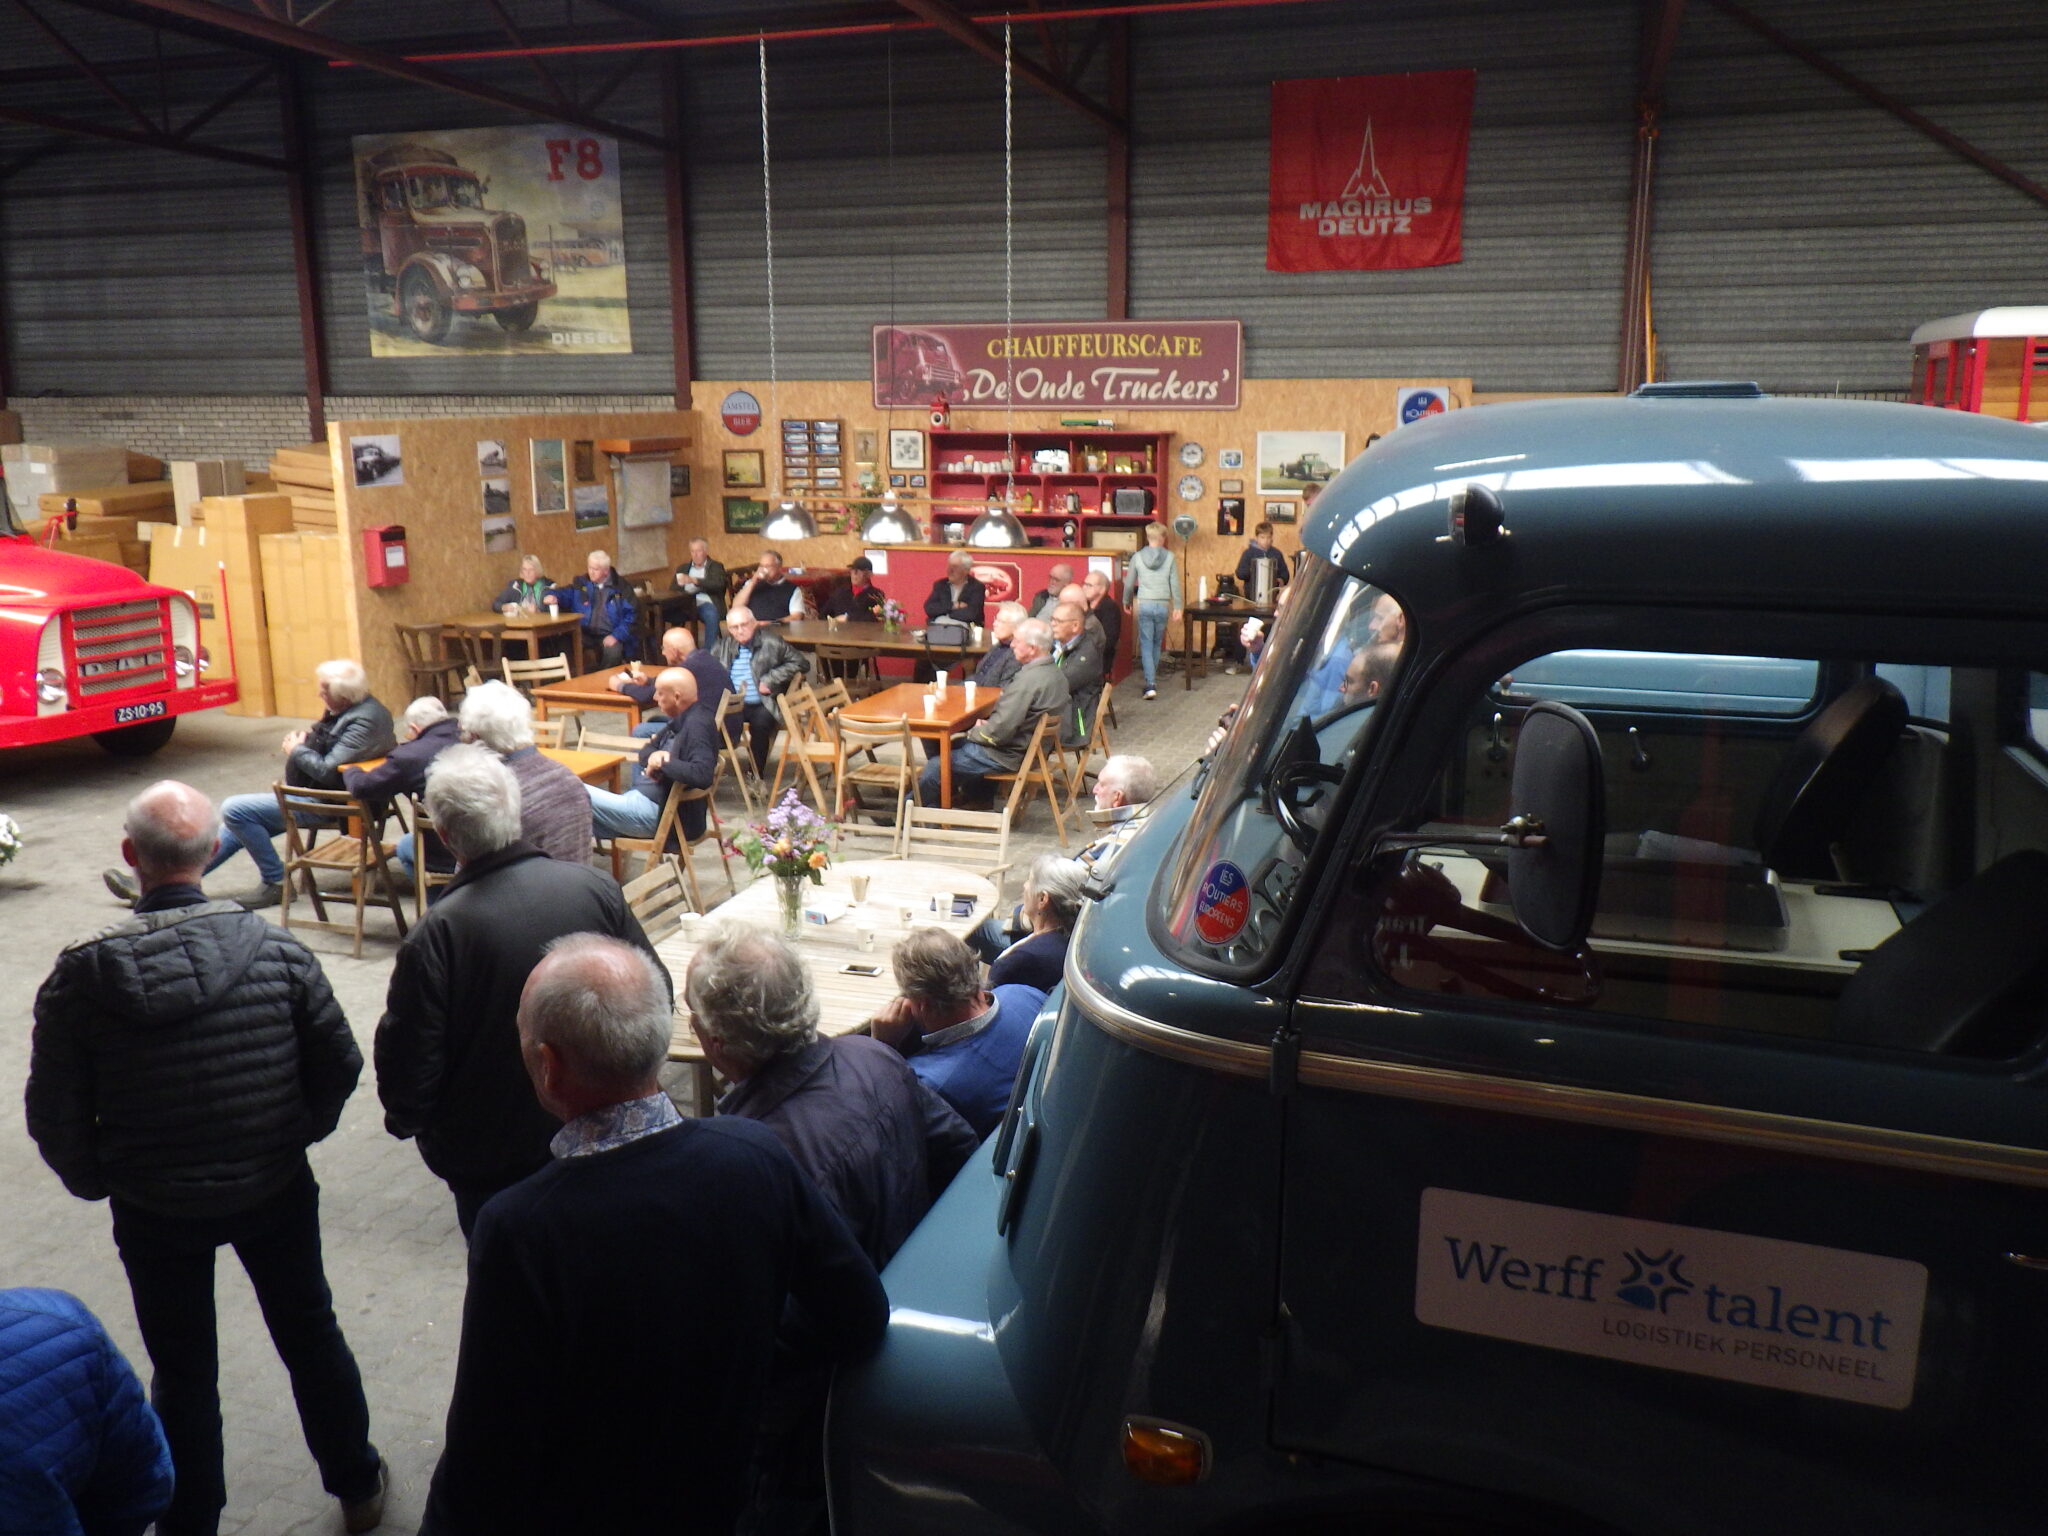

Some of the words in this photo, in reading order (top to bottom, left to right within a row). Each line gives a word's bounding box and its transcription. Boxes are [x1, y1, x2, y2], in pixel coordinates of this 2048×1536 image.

[545, 138, 604, 181] F8
[1300, 197, 1433, 220] MAGIRUS
[1318, 216, 1412, 236] DEUTZ
[551, 332, 619, 345] DIESEL
[987, 333, 1202, 359] CHAUFFEURSCAFE
[1015, 367, 1086, 399] Oude
[727, 402, 757, 410] AMSTEL
[1201, 881, 1244, 913] ROUTIERS
[1444, 1236, 1604, 1302] Werff
[1705, 1286, 1893, 1351] talent
[1603, 1318, 1724, 1353] LOGISTIEK
[1733, 1339, 1887, 1382] PERSONEEL
